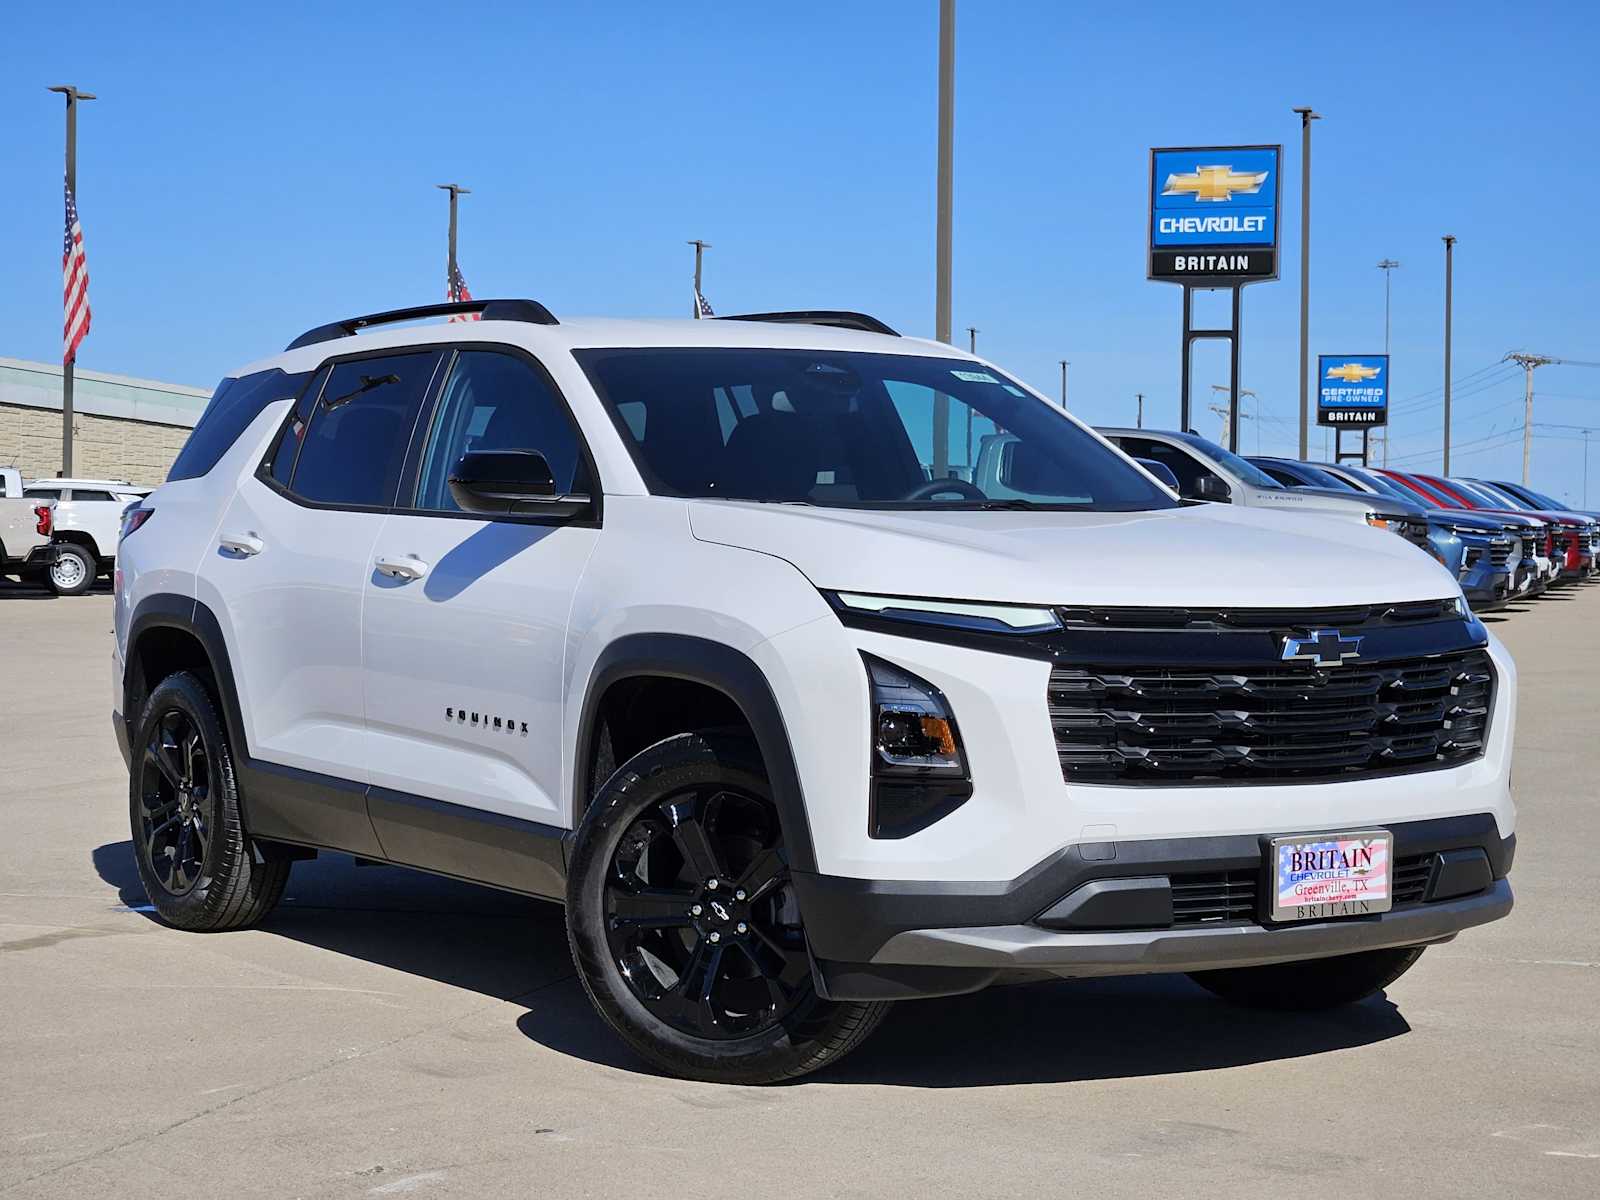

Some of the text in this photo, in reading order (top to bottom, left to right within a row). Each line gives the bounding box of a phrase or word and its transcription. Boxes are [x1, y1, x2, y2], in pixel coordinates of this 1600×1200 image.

[1160, 216, 1267, 233] CHEVROLET
[1174, 255, 1249, 271] BRITAIN
[1322, 388, 1383, 396] CERTIFIED
[1328, 411, 1376, 421] BRITAIN
[446, 707, 528, 733] EQUINOX
[1291, 848, 1373, 872] BRITAIN
[1290, 870, 1349, 882] CHEVROLET
[1295, 880, 1368, 896] Greenville, TX
[1297, 901, 1369, 918] BRITAIN
